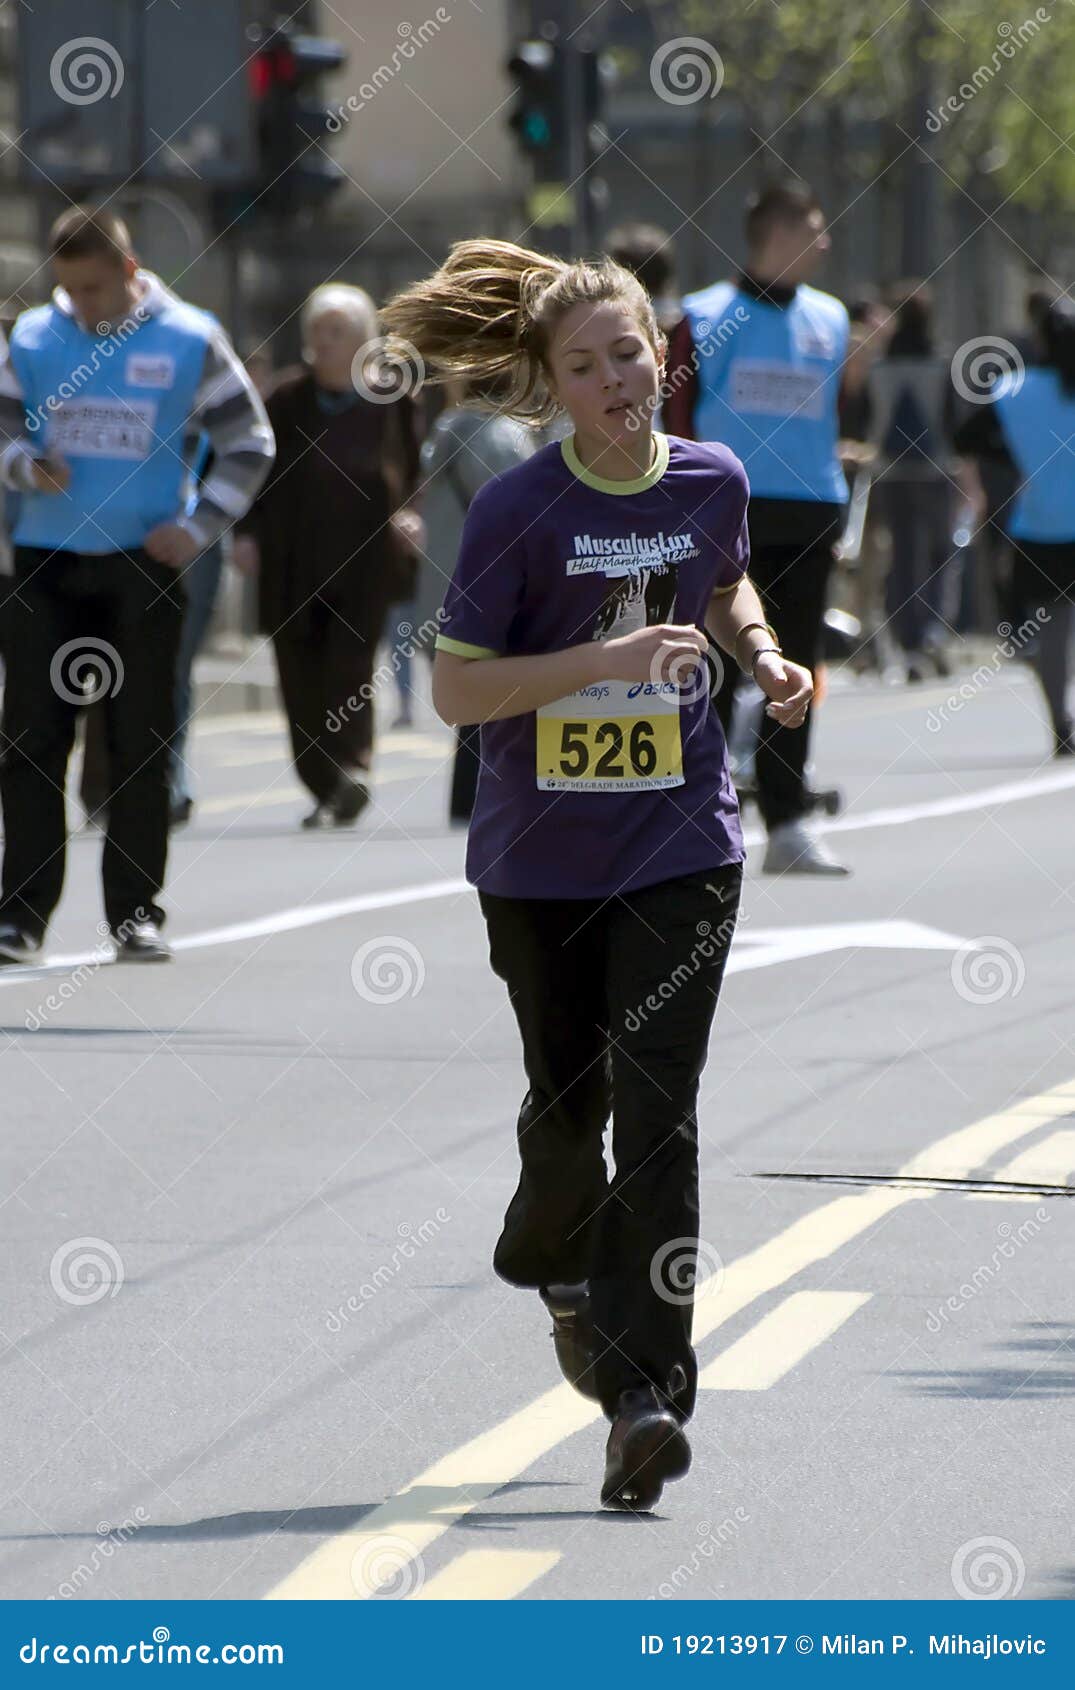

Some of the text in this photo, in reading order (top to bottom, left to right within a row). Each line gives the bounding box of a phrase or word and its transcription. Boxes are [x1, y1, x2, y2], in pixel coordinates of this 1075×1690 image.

[574, 532, 695, 556] MusculusLux
[572, 549, 701, 573] Half Marathon Team
[560, 721, 657, 778] 526
[571, 780, 613, 790] BELGRADE
[615, 779, 663, 790] MARATHON
